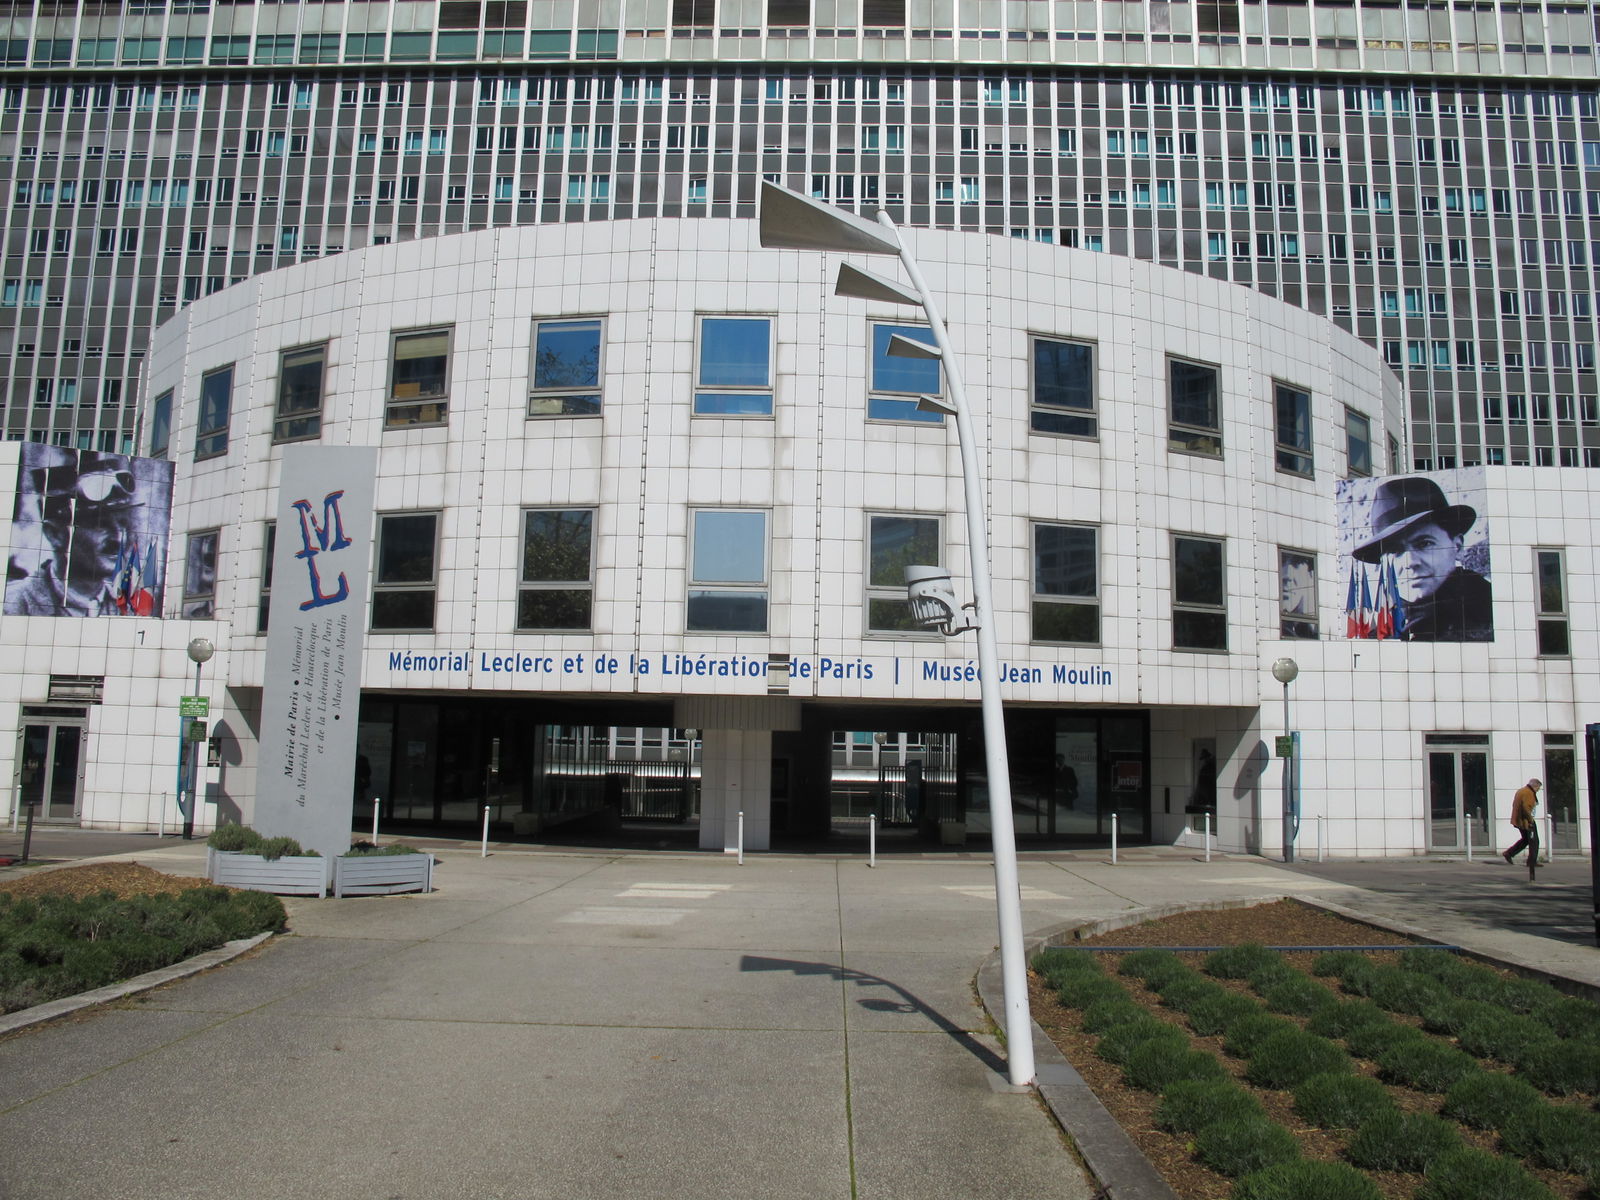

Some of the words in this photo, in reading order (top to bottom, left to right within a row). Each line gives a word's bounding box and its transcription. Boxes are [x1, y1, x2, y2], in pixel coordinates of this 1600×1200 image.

[322, 618, 333, 642] Paris
[336, 614, 348, 650] Moulin
[291, 626, 303, 675] Mémorial
[304, 622, 320, 687] Hauteclocque
[321, 646, 331, 658] de
[334, 654, 346, 677] Jean
[389, 651, 469, 672] Mémorial
[481, 652, 553, 673] Leclerc
[563, 656, 584, 674] et
[595, 653, 619, 675] de
[629, 654, 649, 675] la
[788, 657, 811, 679] de
[820, 658, 874, 680] Paris
[999, 662, 1042, 684] Jean
[1052, 664, 1112, 686] Moulin
[303, 691, 312, 702] de
[317, 661, 330, 712] Libération
[332, 679, 344, 709] Musée
[288, 691, 299, 720] Paris
[287, 723, 296, 736] de
[300, 706, 312, 739] Leclerc
[315, 729, 325, 741] de
[316, 716, 326, 726] la
[284, 739, 296, 778] Mairie
[297, 742, 309, 790] Maréchal
[296, 794, 305, 807] du
